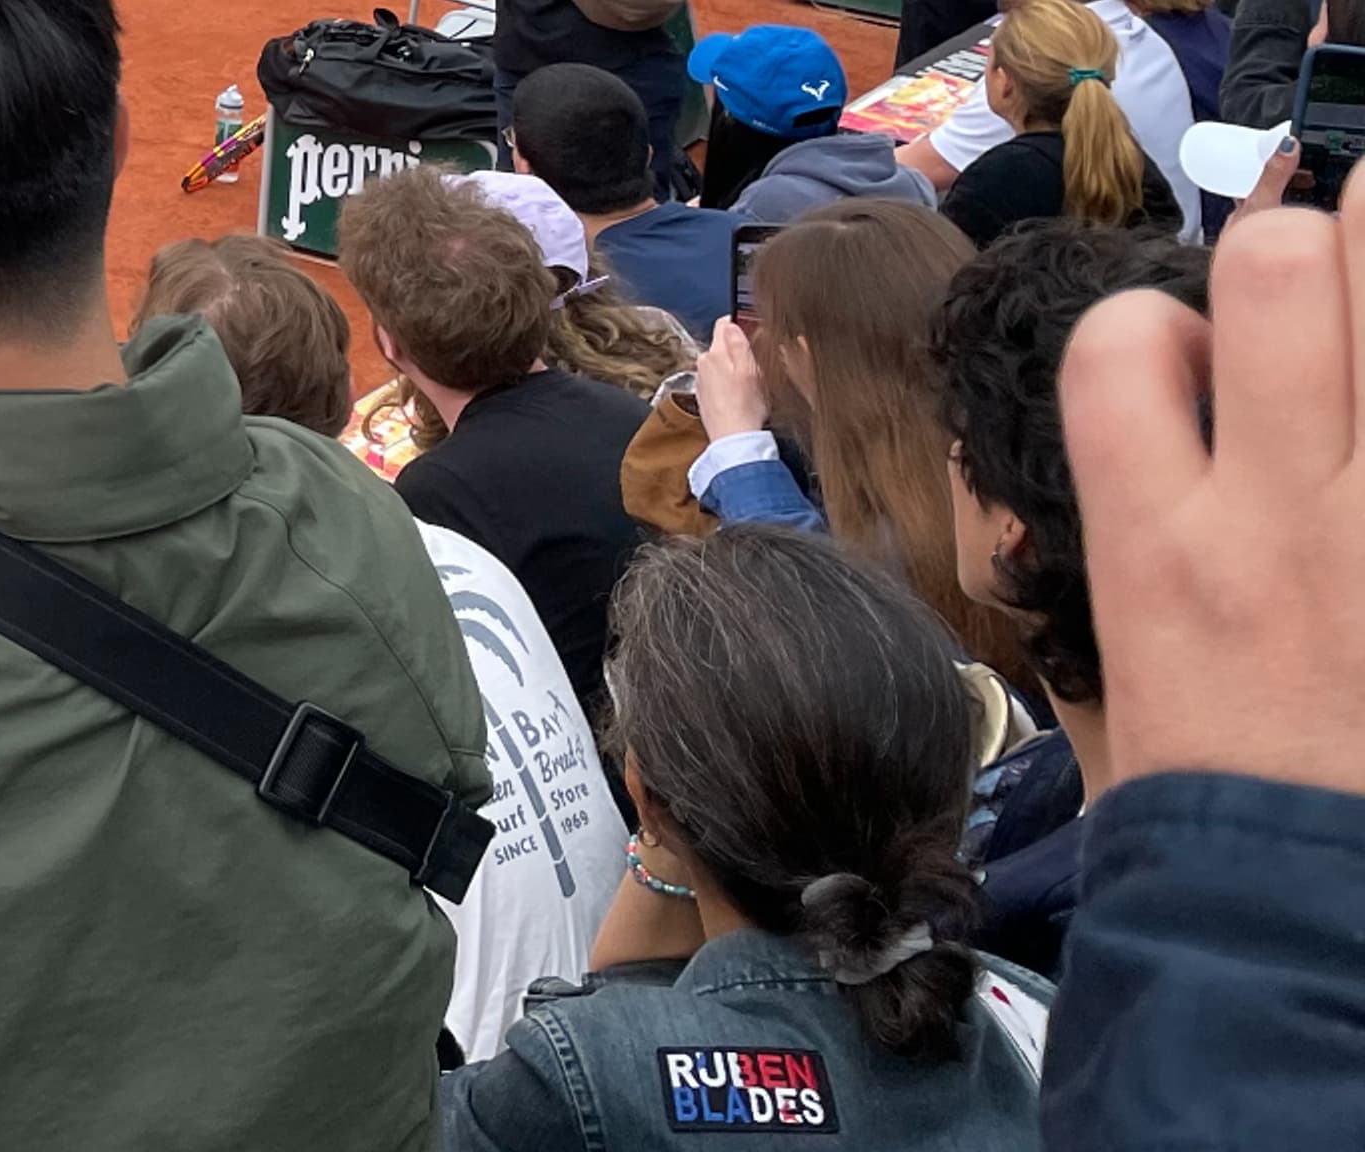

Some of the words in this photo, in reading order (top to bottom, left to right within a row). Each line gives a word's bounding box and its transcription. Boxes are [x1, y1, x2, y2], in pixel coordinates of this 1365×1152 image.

[281, 134, 422, 241] perri
[496, 804, 527, 833] urf
[549, 782, 590, 812] Store
[494, 835, 539, 866] SINCE
[560, 809, 590, 835] 1969
[666, 1052, 819, 1089] RUBEN
[673, 1085, 825, 1125] BLADES
